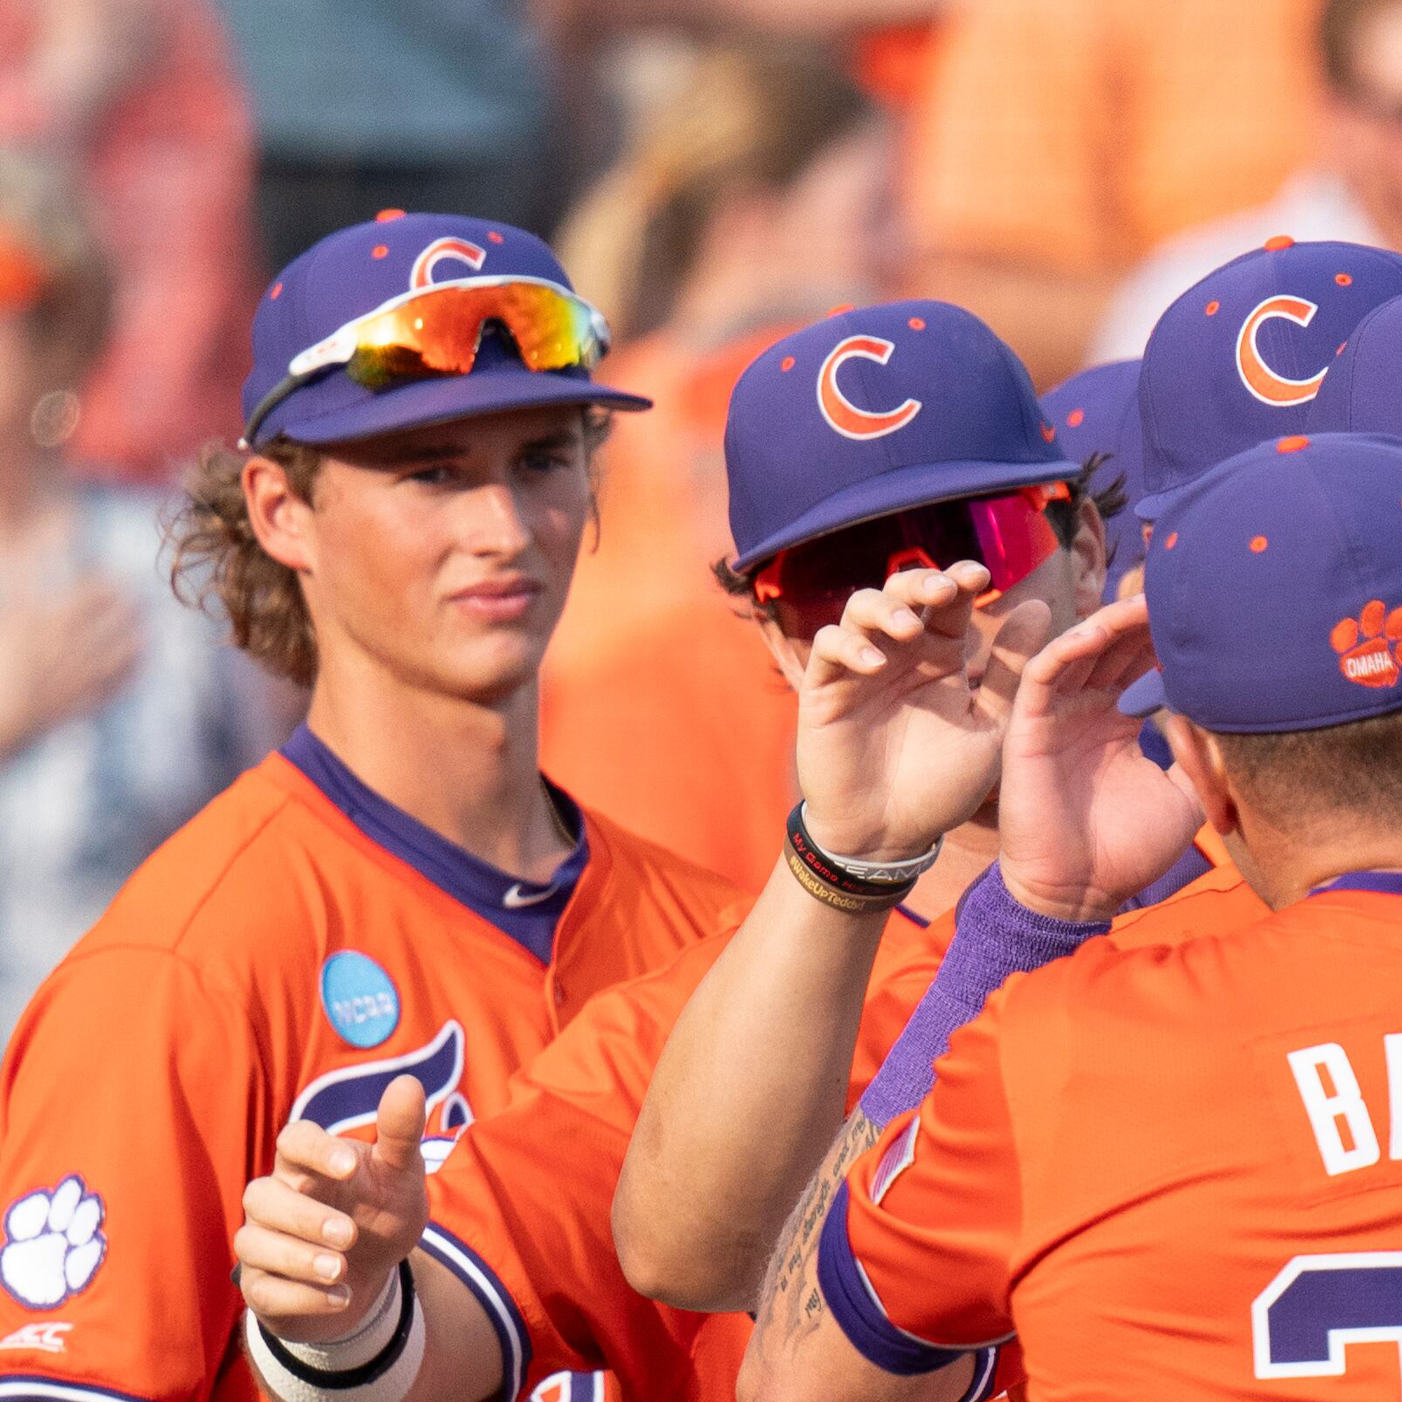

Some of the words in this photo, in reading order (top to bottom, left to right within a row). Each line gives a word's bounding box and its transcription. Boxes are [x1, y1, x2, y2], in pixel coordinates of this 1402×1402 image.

[1236, 294, 1328, 407] C
[817, 335, 923, 440] C
[1346, 650, 1394, 679] OMAHA
[834, 859, 922, 882] EAM
[333, 991, 394, 1025] NCAA
